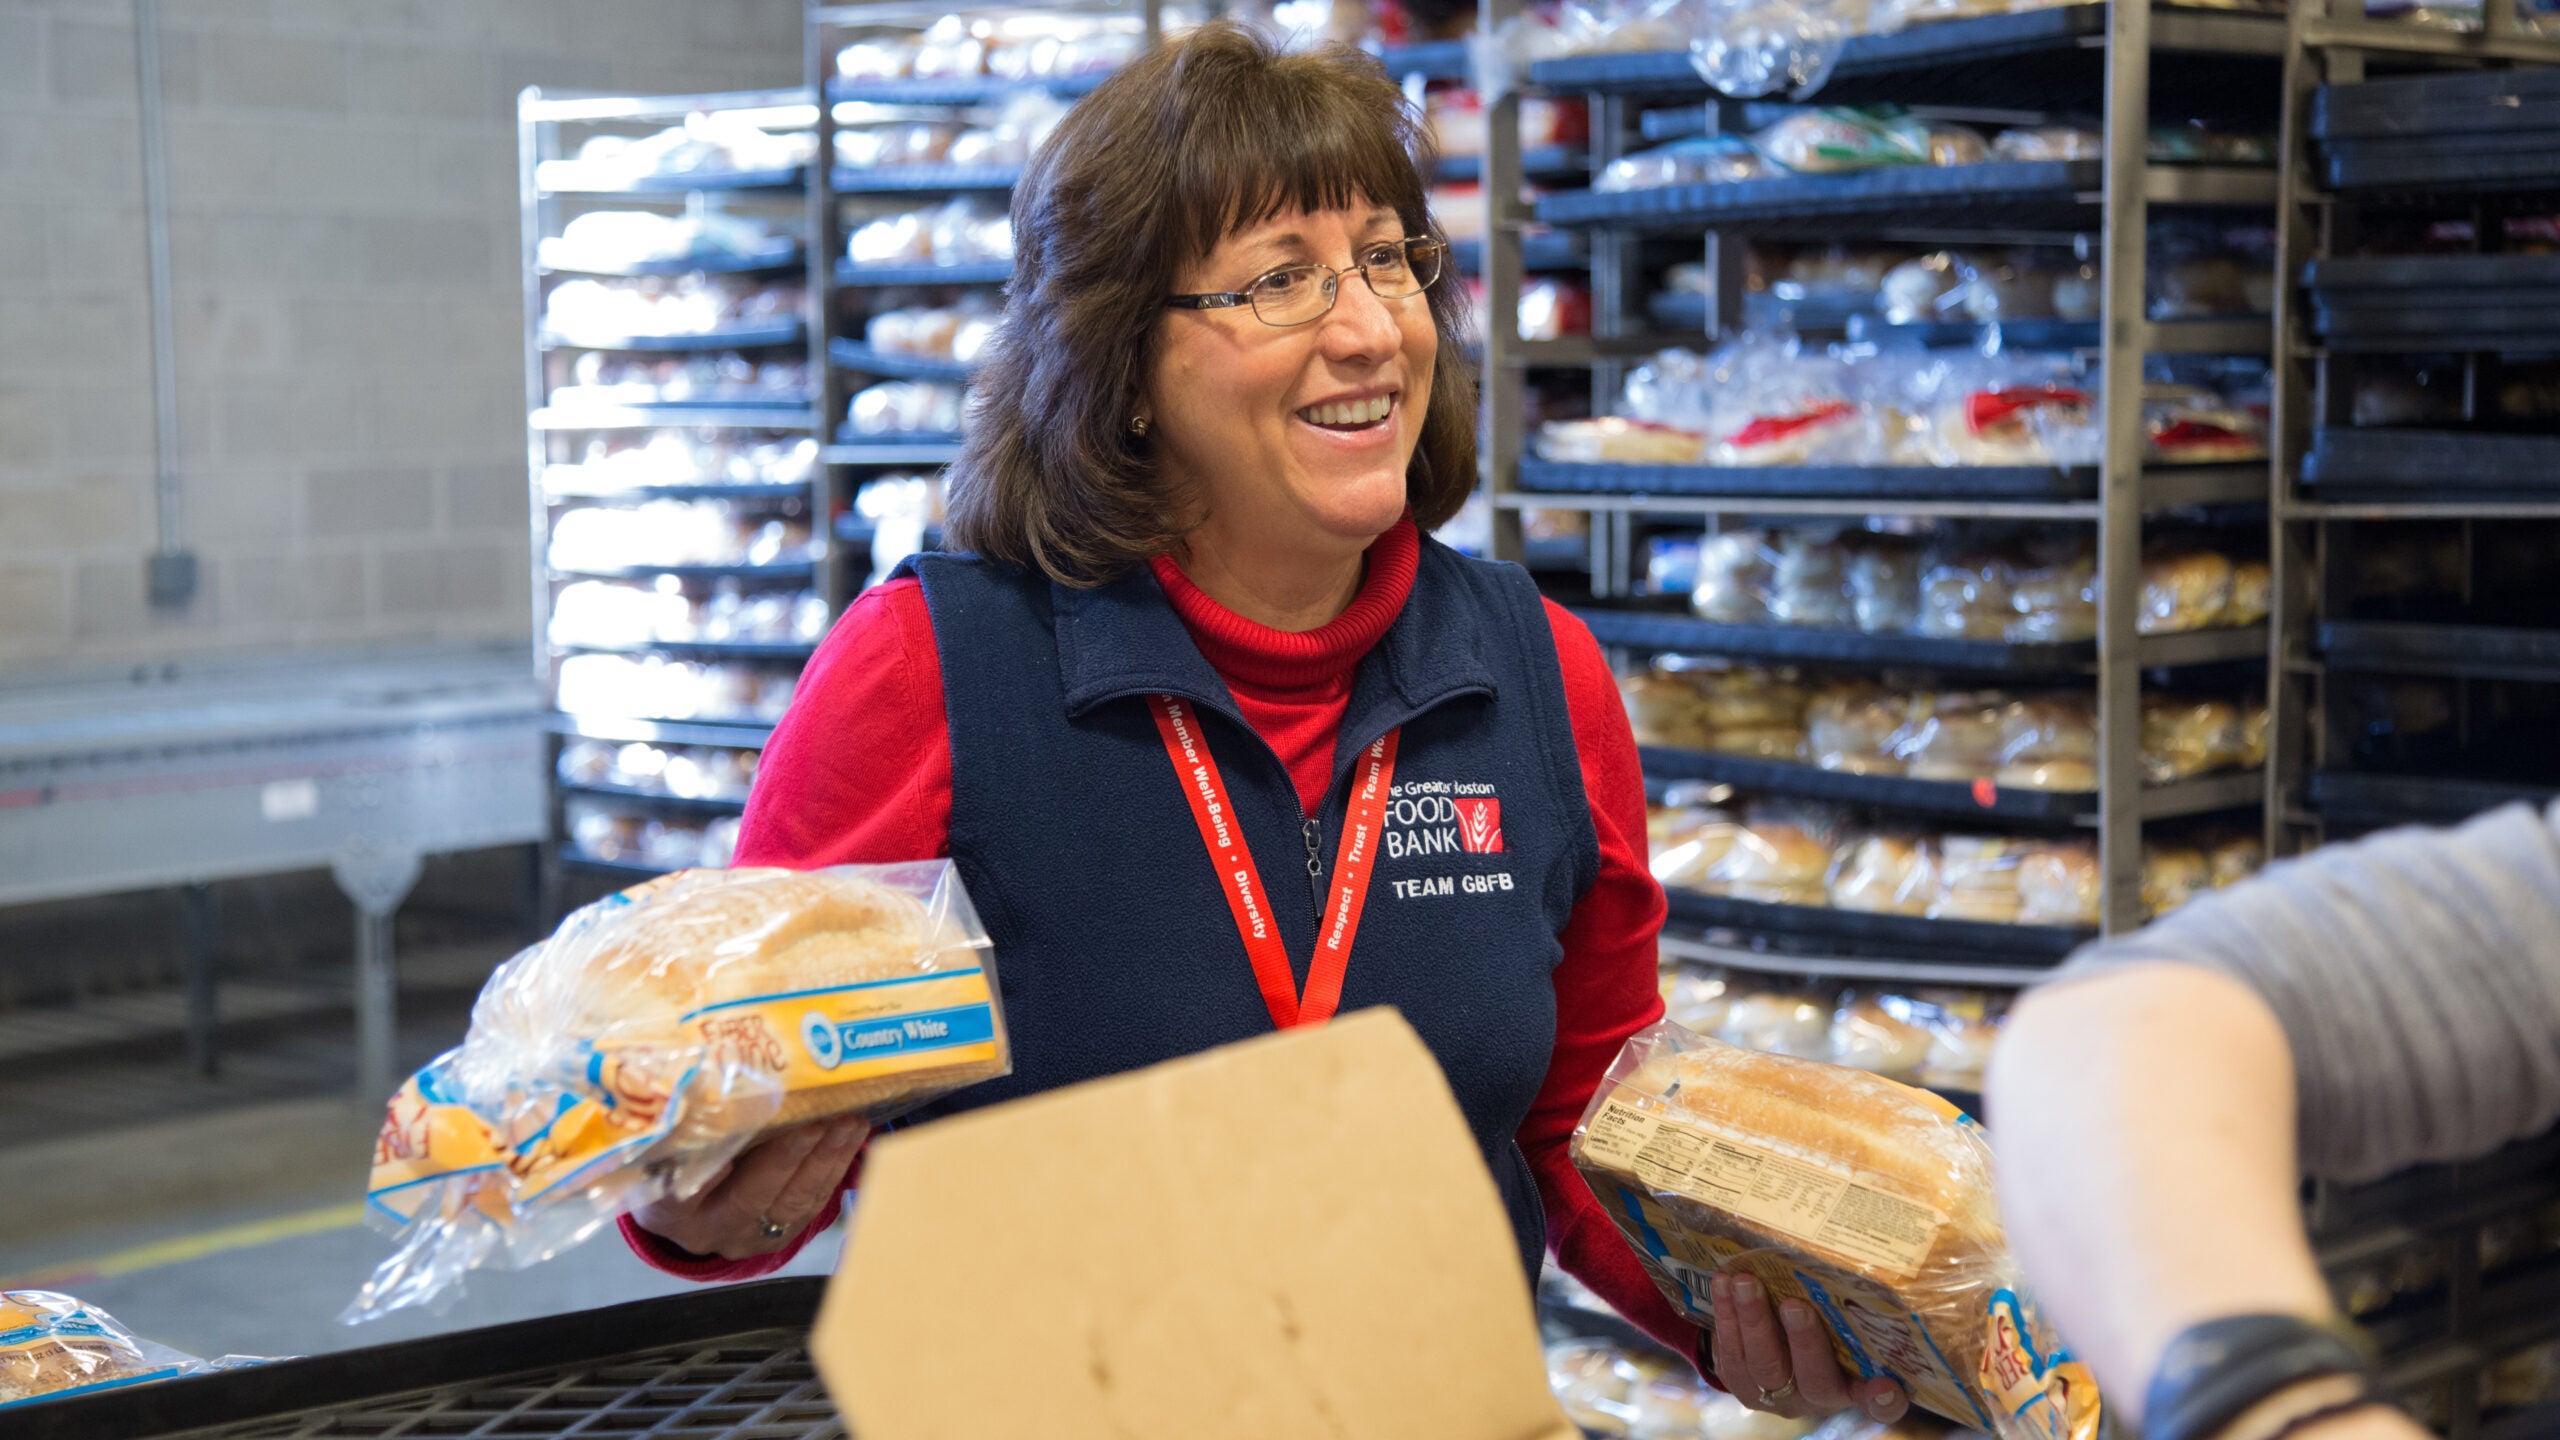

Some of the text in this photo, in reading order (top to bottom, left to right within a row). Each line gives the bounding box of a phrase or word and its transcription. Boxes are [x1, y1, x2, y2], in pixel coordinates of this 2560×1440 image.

[1167, 704, 1267, 939] Member Well-Being Diversity
[1383, 796, 1456, 827] FOOD
[1327, 735, 1386, 950] Respect Trust Team Wo
[1386, 827, 1461, 858] BANK
[1392, 872, 1515, 899] TEAM GBFB
[843, 1027, 903, 1050] Country
[902, 1018, 948, 1042] White
[1601, 1111, 1626, 1126] Facts
[1607, 1104, 1646, 1124] Nutrition
